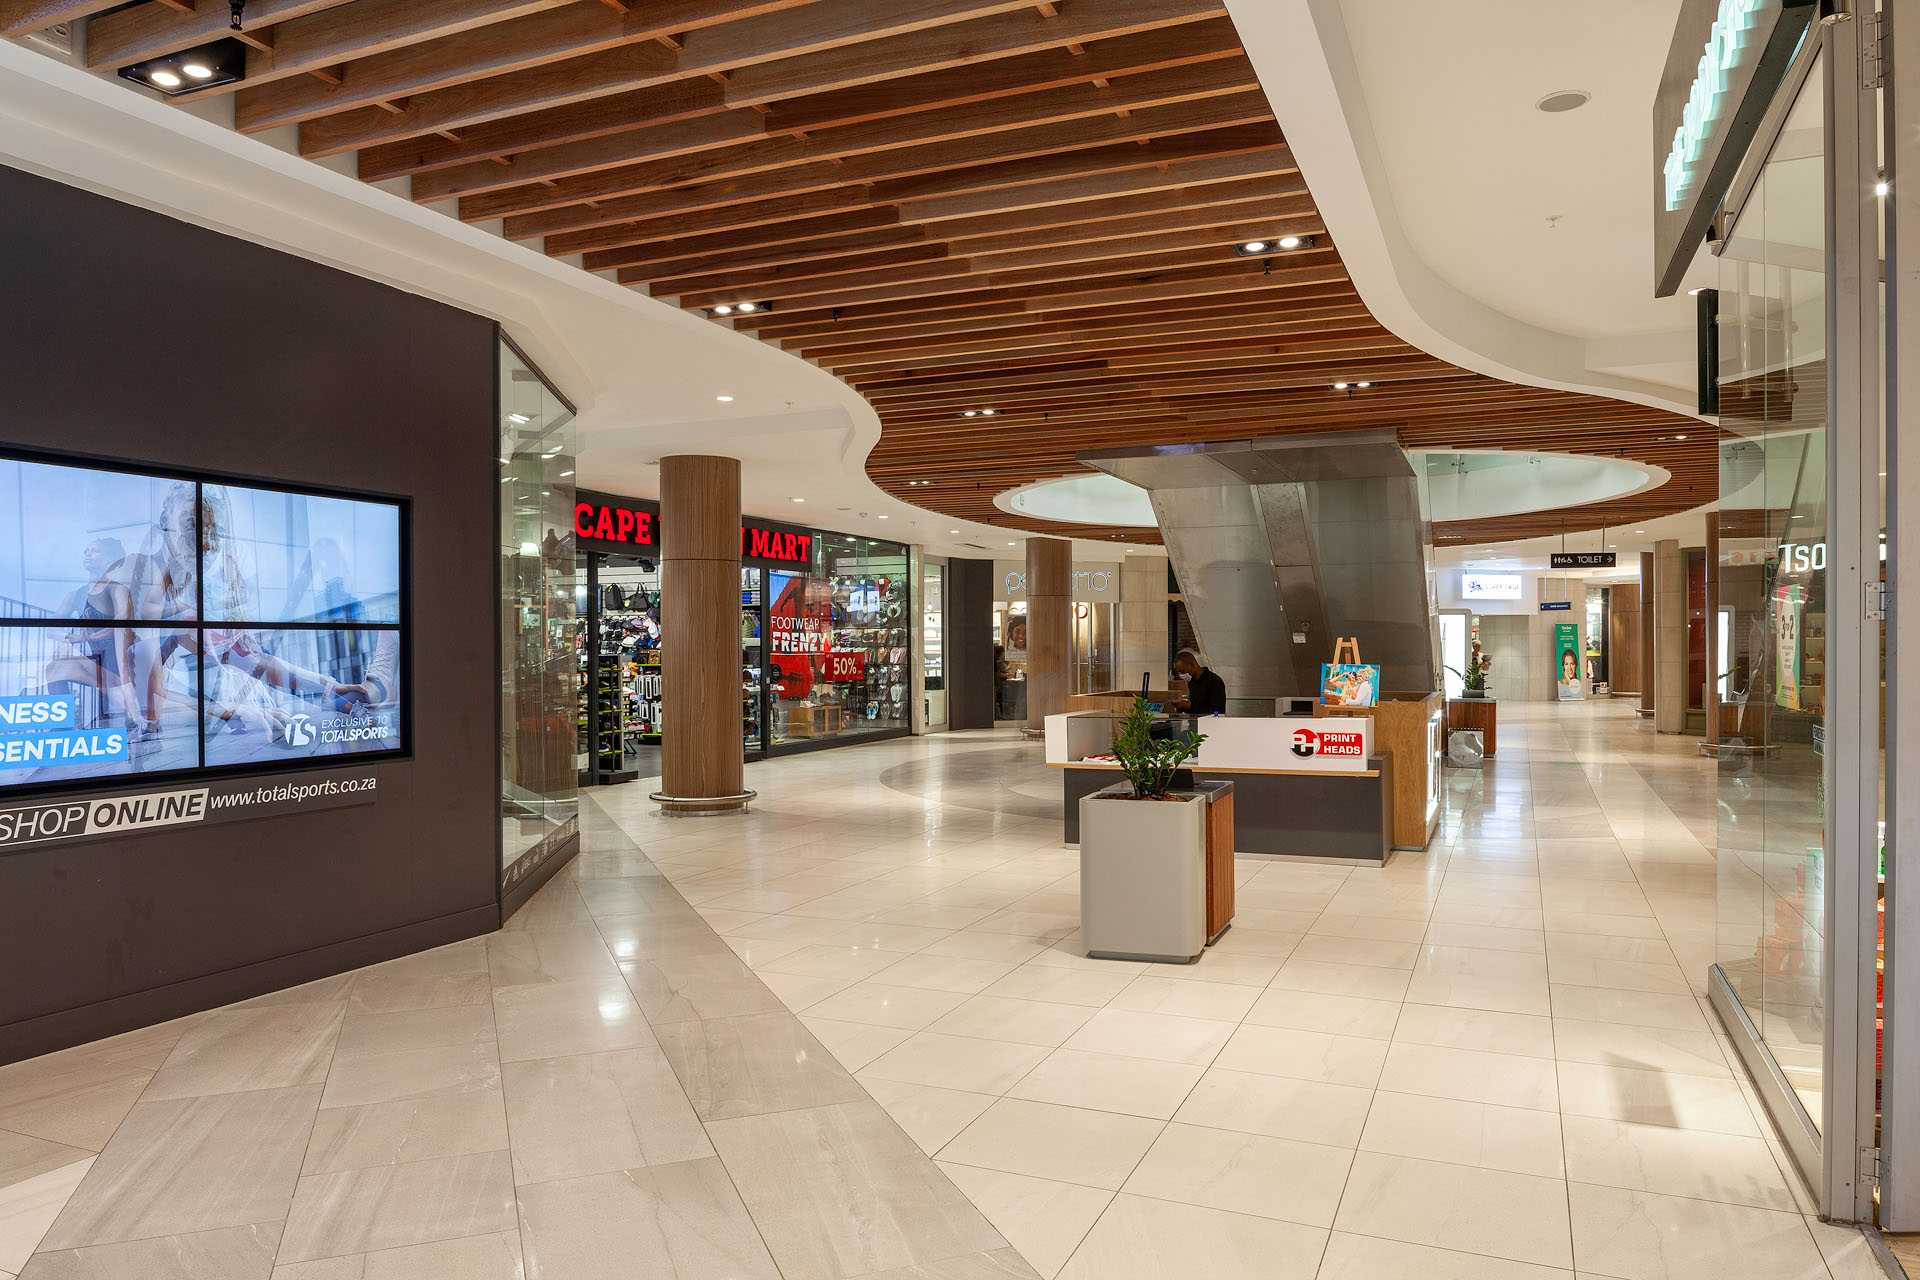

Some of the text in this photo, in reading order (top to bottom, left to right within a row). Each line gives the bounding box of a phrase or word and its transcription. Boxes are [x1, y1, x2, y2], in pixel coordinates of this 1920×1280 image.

[575, 503, 651, 545] CAPE
[751, 528, 811, 562] MART
[1577, 555, 1603, 564] TOILET
[771, 616, 820, 630] FOOTWEAR
[772, 631, 828, 652] FRENZY
[833, 657, 857, 676] 50%
[0, 701, 68, 724] NESS
[321, 715, 389, 729] EXCLUSIVE TO
[321, 726, 389, 744] TOTALSPORTS
[1323, 734, 1356, 742] PRINT
[1323, 745, 1360, 754] HEADS
[0, 777, 377, 841] SHOP ONLINE www.totalsports.co.za
